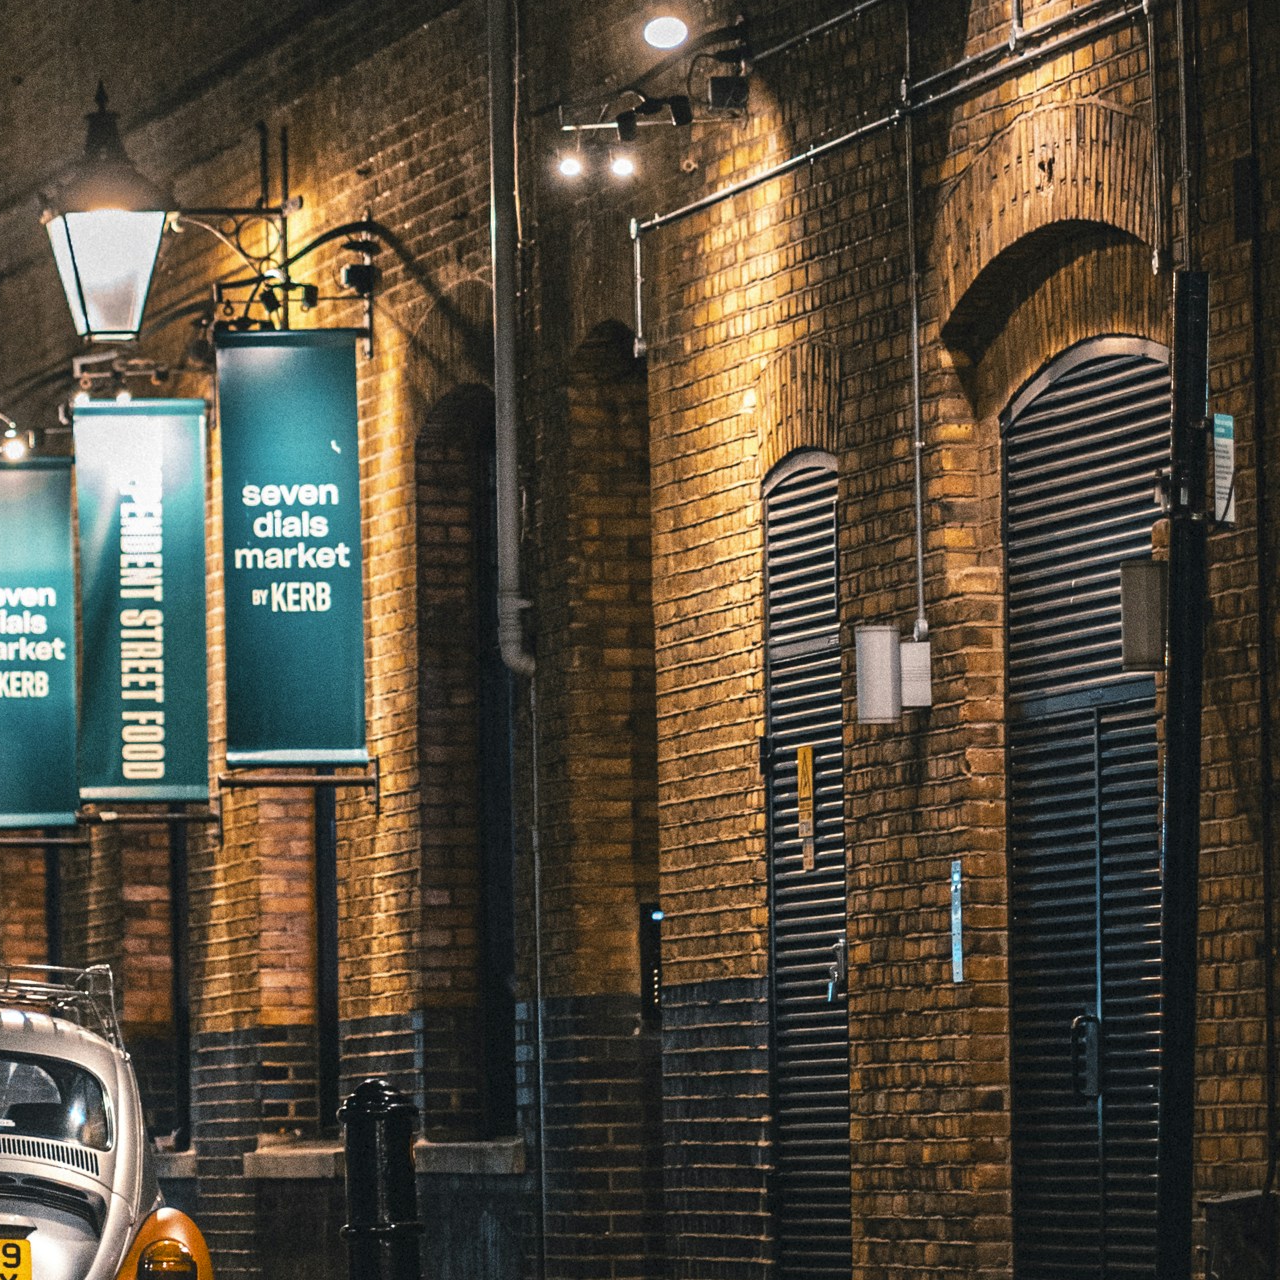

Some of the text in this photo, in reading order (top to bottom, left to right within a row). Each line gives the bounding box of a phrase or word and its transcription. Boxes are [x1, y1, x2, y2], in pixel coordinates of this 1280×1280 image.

[241, 483, 339, 507] seven
[253, 509, 329, 538] dials
[234, 542, 351, 569] market
[252, 581, 331, 612] BY KERB
[120, 609, 164, 703] STREET
[121, 710, 165, 780] FOOD
